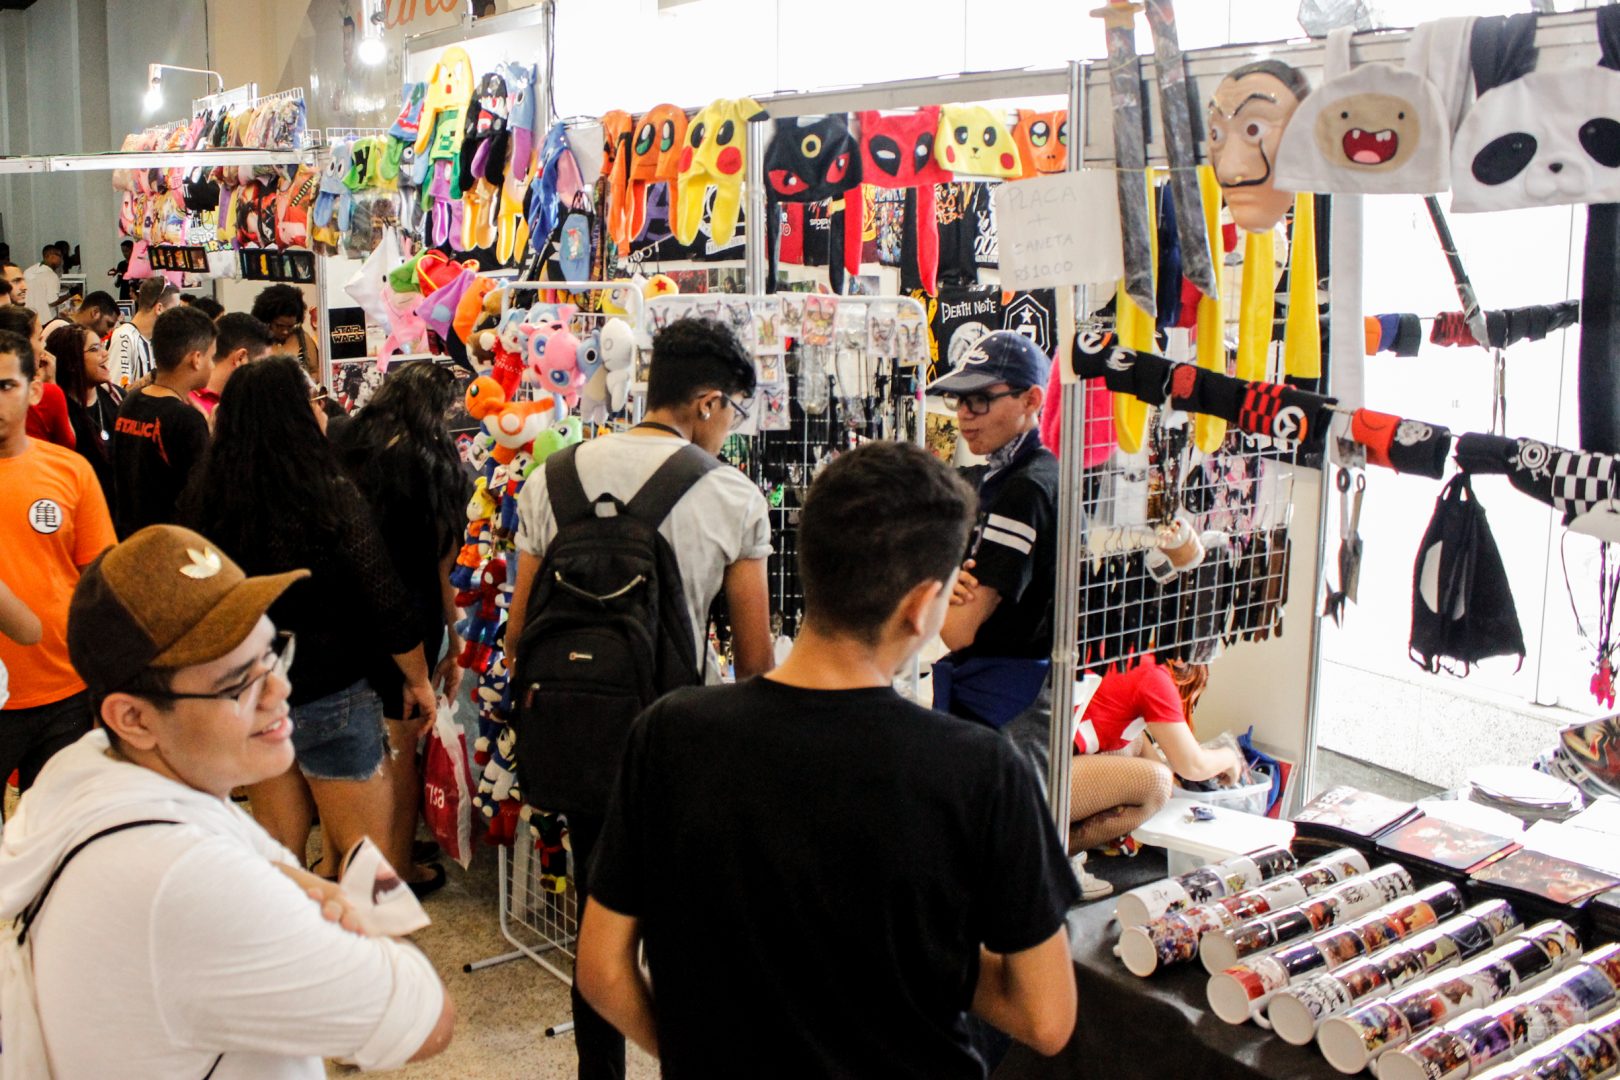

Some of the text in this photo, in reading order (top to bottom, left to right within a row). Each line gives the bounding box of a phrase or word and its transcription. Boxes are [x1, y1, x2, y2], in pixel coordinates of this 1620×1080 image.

[1008, 186, 1077, 211] PLACA
[941, 298, 996, 323] DEATH NOTE
[331, 325, 365, 336] STAR
[331, 332, 365, 344] WARS
